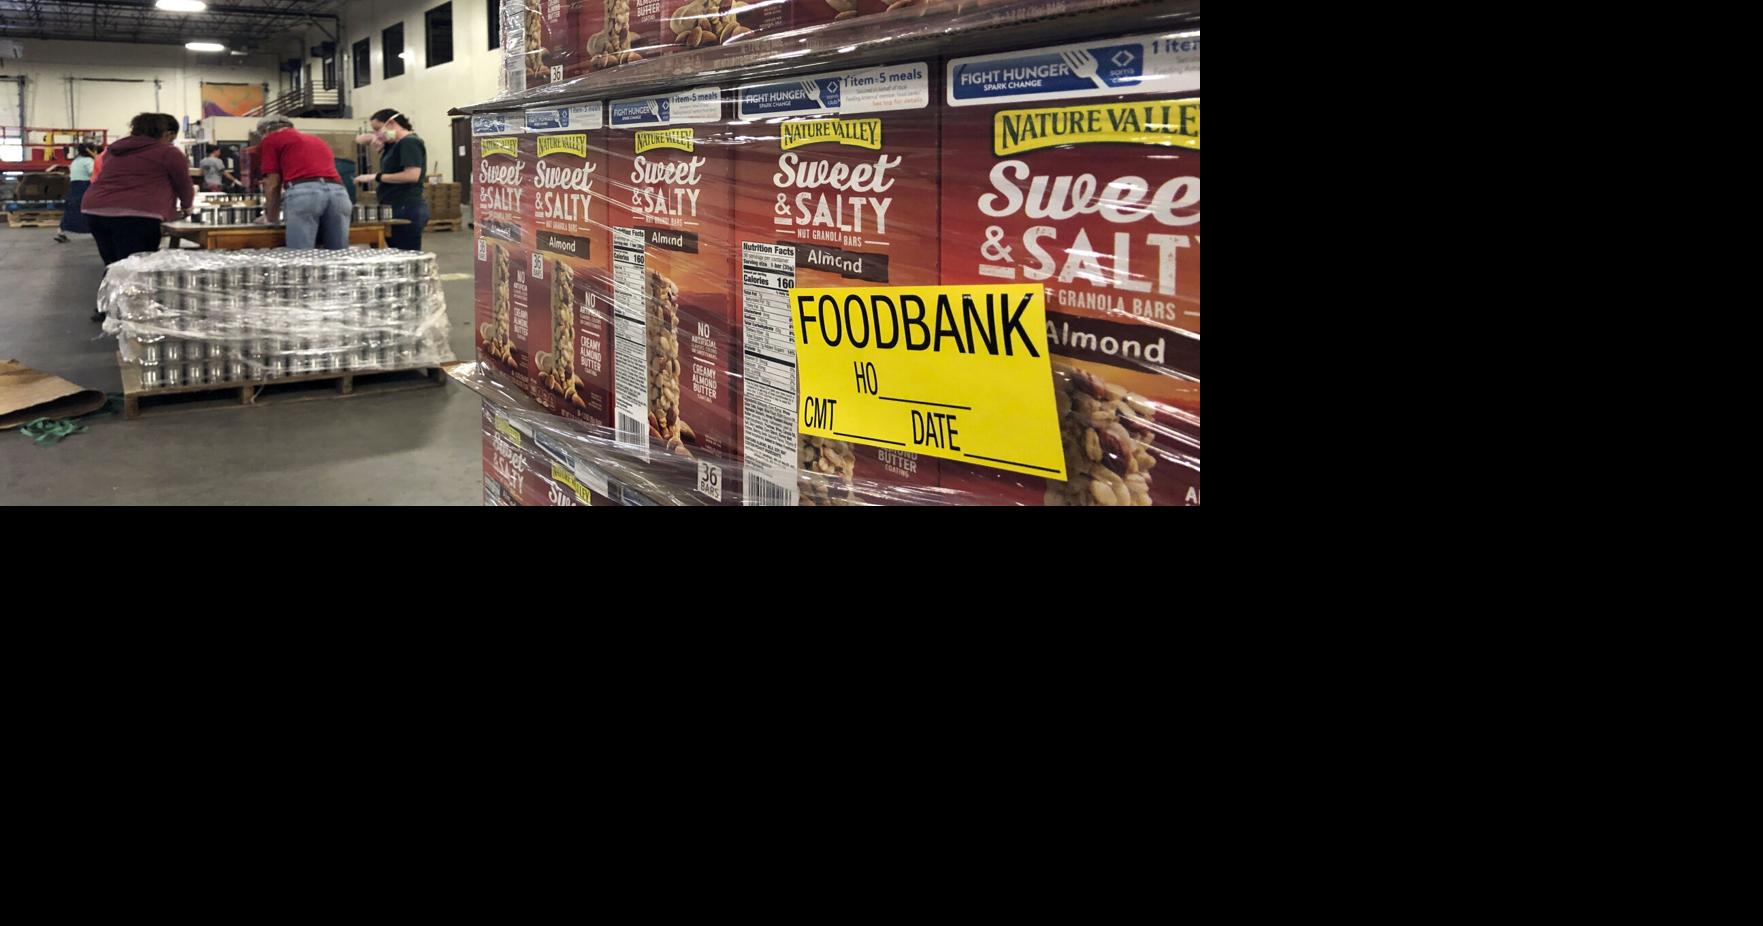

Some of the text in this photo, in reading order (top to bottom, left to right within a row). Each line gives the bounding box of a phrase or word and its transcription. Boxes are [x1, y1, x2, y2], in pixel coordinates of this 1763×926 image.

[1152, 40, 1158, 54] 1
[553, 66, 561, 81] 36
[889, 69, 922, 83] meals
[960, 63, 1069, 86] FIGHT HUNGER
[983, 79, 1042, 91] SPARK CHANGE
[698, 92, 718, 101] meals
[745, 89, 806, 103] FIGHT HUNGER
[629, 106, 649, 115] HUNGER
[784, 120, 878, 146] NATURE VALLEY
[1002, 104, 1200, 149] NATURE VALLE
[539, 135, 586, 157] NATURE VALLEY
[637, 132, 664, 151] NATURE
[479, 159, 526, 186] Sweet
[534, 158, 597, 191] Sweet
[631, 155, 706, 185] Sweet
[772, 151, 902, 192] Sweet
[544, 191, 592, 222] SALTY
[643, 187, 700, 217] SALTY
[795, 191, 893, 234] SALTY
[549, 236, 576, 254] Almond
[796, 228, 862, 247] NUT GRANOLA BARS
[614, 252, 645, 264] Calories 160
[743, 243, 794, 256] Nutrition Facts
[808, 247, 863, 274] Almond
[1022, 225, 1200, 297] SALT
[743, 274, 794, 289] Calories 160
[585, 291, 596, 308] NO
[1058, 289, 1125, 313] GRANOLA
[1132, 298, 1177, 321] BARS
[697, 321, 710, 338] NO
[797, 293, 1040, 358] FOODBANK
[580, 335, 600, 353] CREAMY
[1046, 319, 1166, 364] Almond
[580, 346, 602, 363] ALMOND
[581, 356, 601, 373] BUTTER
[692, 363, 716, 380] CREAMY
[692, 374, 717, 390] ALMOND
[693, 382, 717, 400] BUTTER
[804, 396, 961, 452] CMT DATE
[878, 449, 917, 474] BUTTER
[702, 462, 718, 486] 36
[700, 480, 719, 499] BARS
